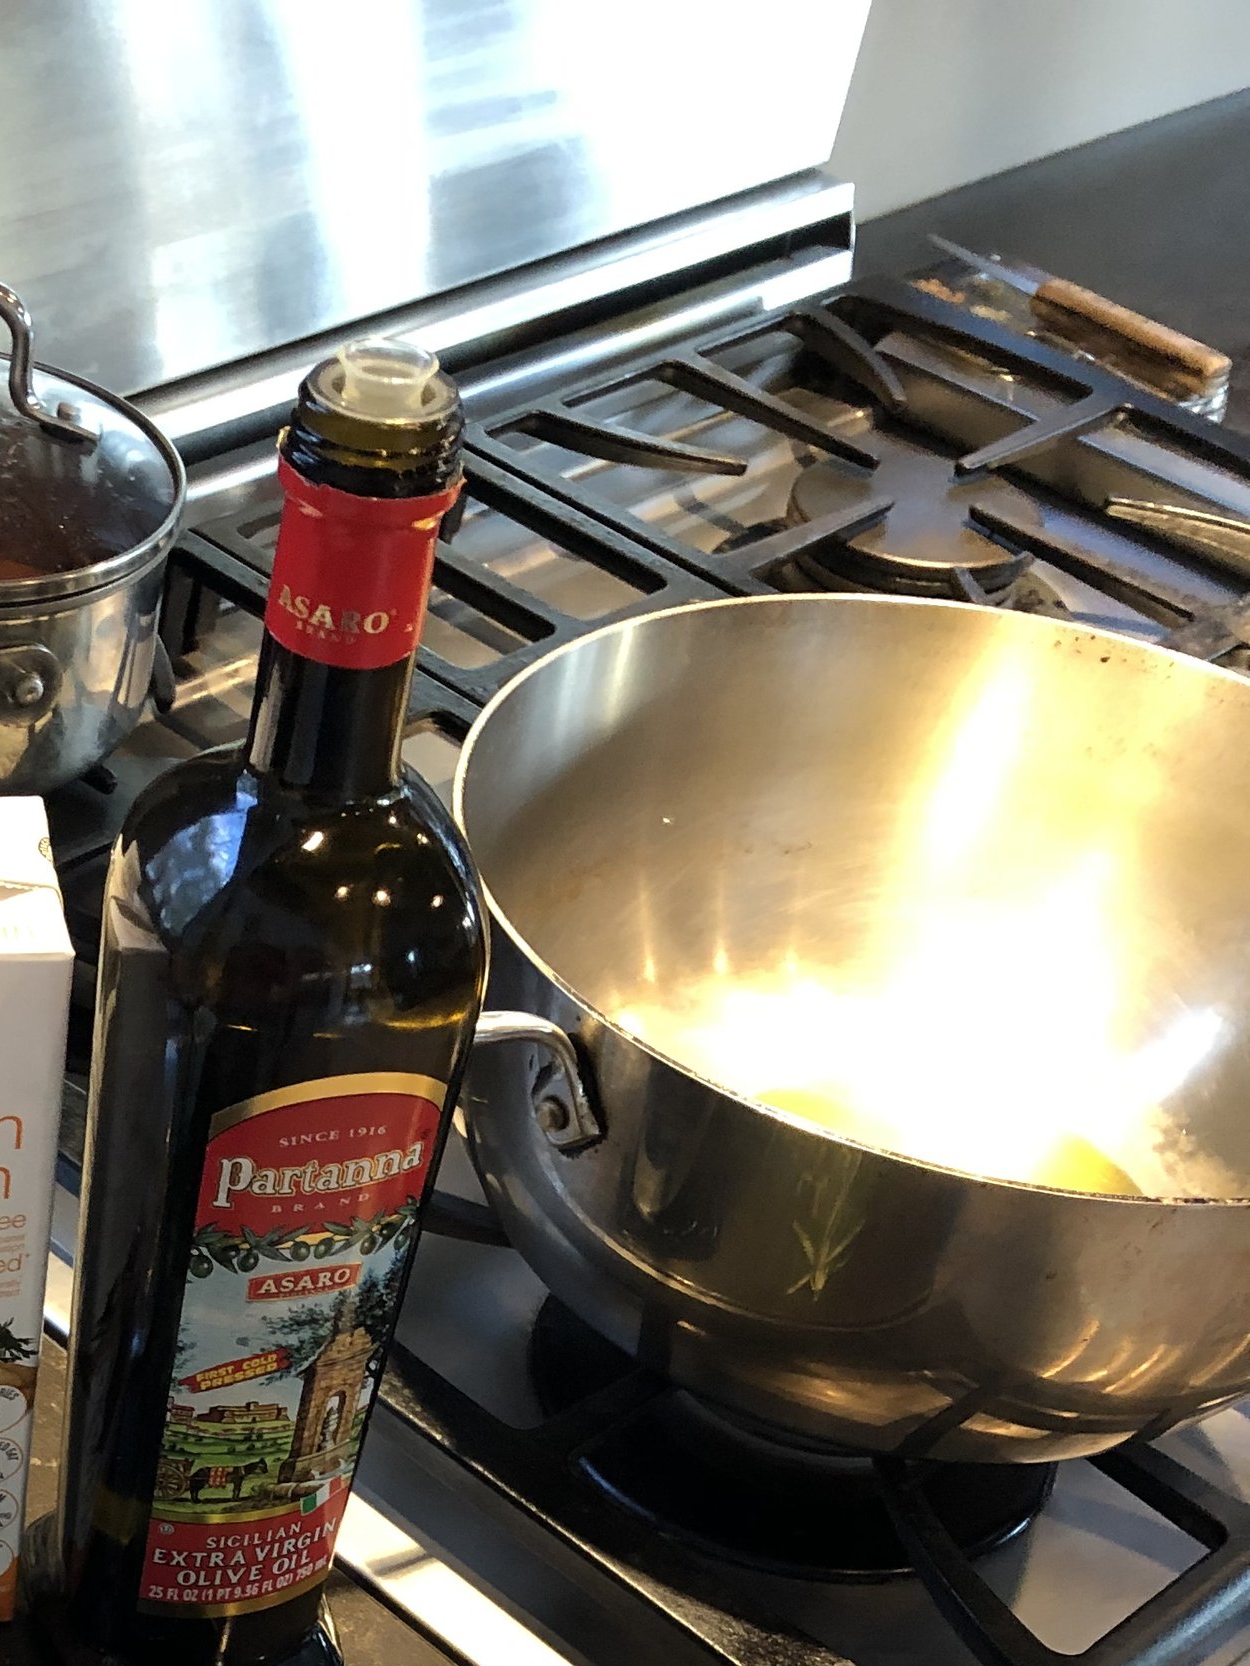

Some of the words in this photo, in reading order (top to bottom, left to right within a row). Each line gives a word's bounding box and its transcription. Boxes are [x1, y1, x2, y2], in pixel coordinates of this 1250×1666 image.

[278, 584, 390, 634] ASARO
[279, 1129, 340, 1147] SINCE
[211, 1141, 424, 1210] Partanna
[271, 1193, 371, 1213] BRAND
[257, 1268, 350, 1294] ASARO
[196, 1364, 236, 1382] FIRST
[242, 1353, 278, 1370] COLD
[200, 1361, 278, 1391] PRESSED
[153, 1548, 245, 1568] EXTRA
[255, 1517, 337, 1562] VIRGIN
[206, 1521, 301, 1549] SICILIAN
[177, 1564, 264, 1586] OLIVE
[272, 1550, 311, 1575] OIL
[149, 1585, 163, 1598] 25
[166, 1587, 179, 1601] FL
[183, 1589, 198, 1601] OZ
[216, 1588, 232, 1601] PT
[262, 1580, 273, 1593] FL
